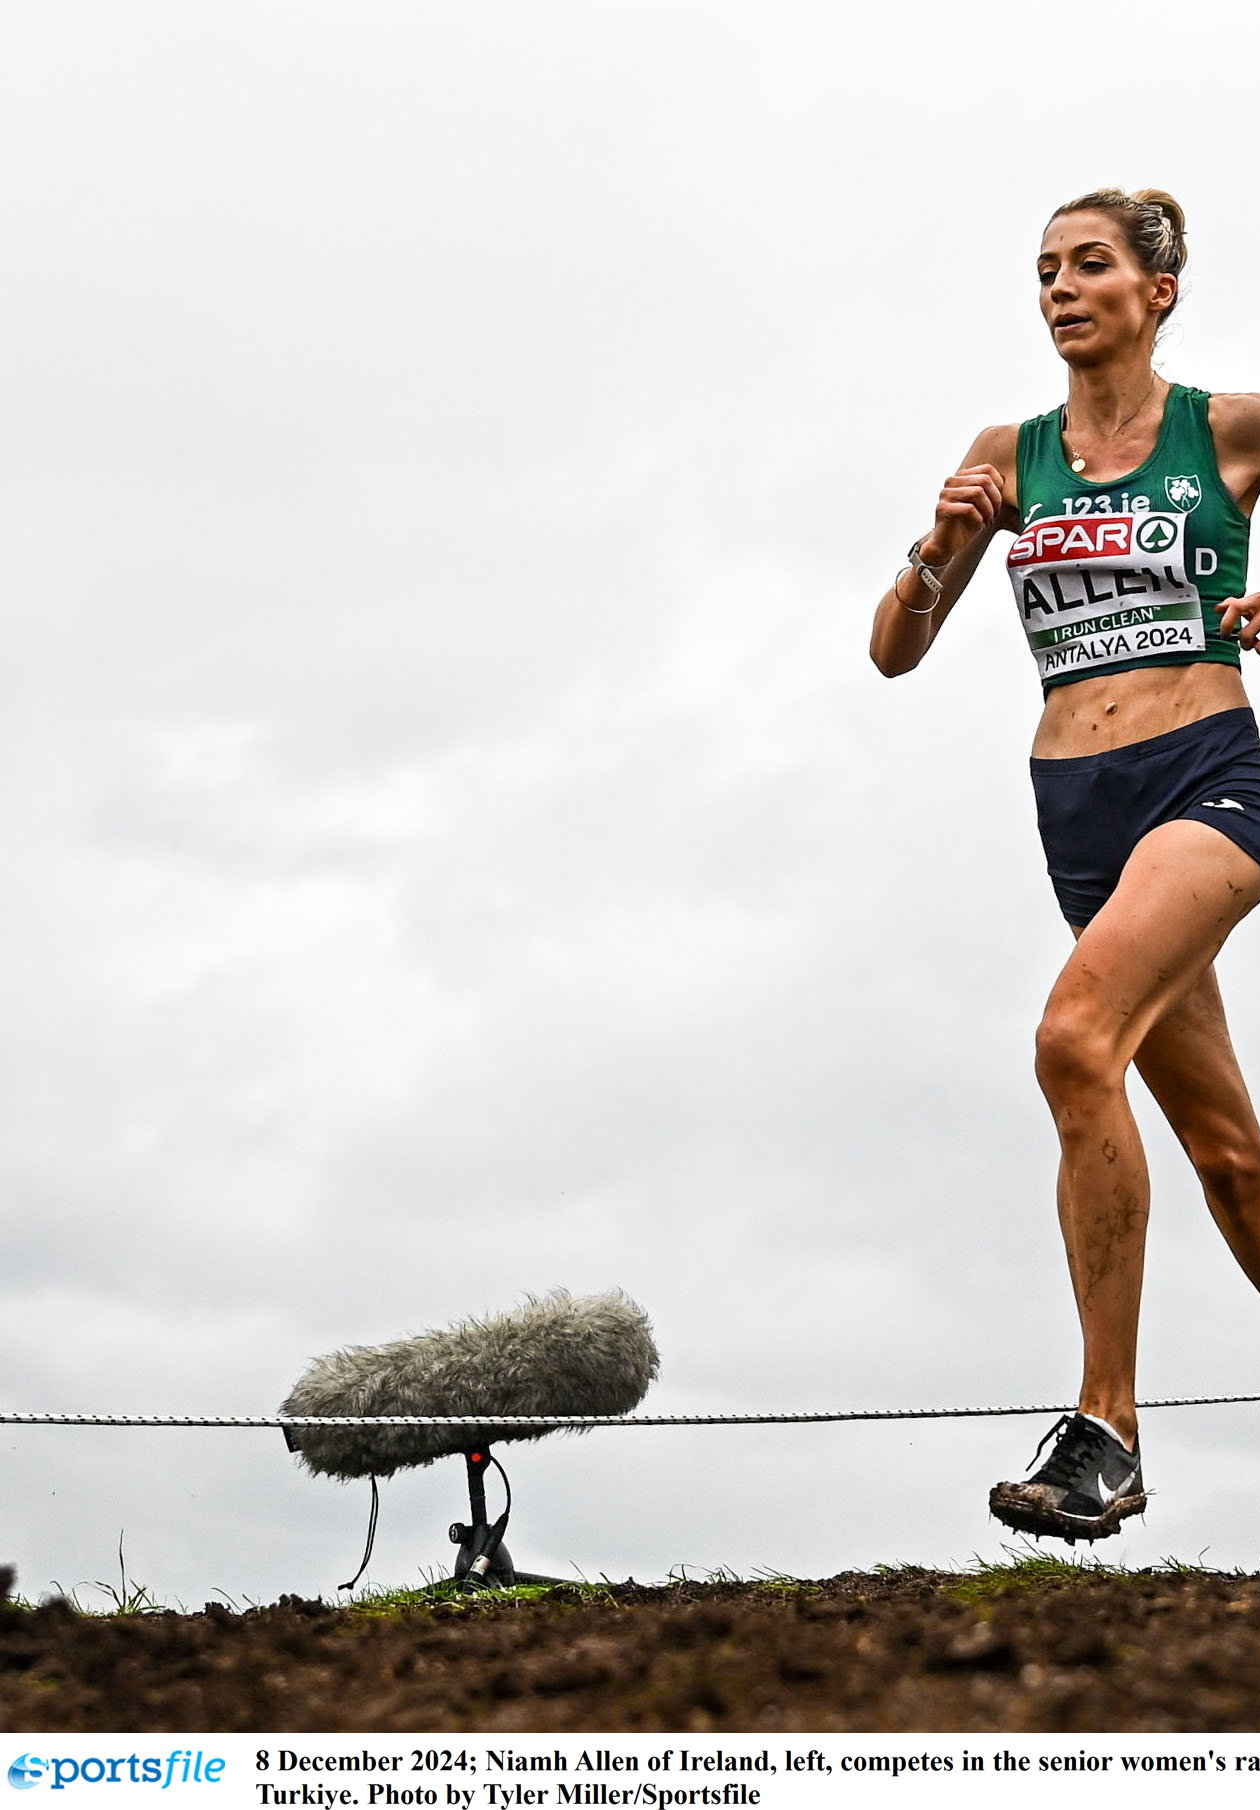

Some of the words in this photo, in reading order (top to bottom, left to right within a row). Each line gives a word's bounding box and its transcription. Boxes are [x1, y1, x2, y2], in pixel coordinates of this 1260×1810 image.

[1009, 522, 1129, 561] SPAR
[1045, 634, 1131, 671] ANTALYA
[1135, 627, 1193, 650] 2024
[1053, 630, 1059, 643] I
[1061, 620, 1096, 640] RUN
